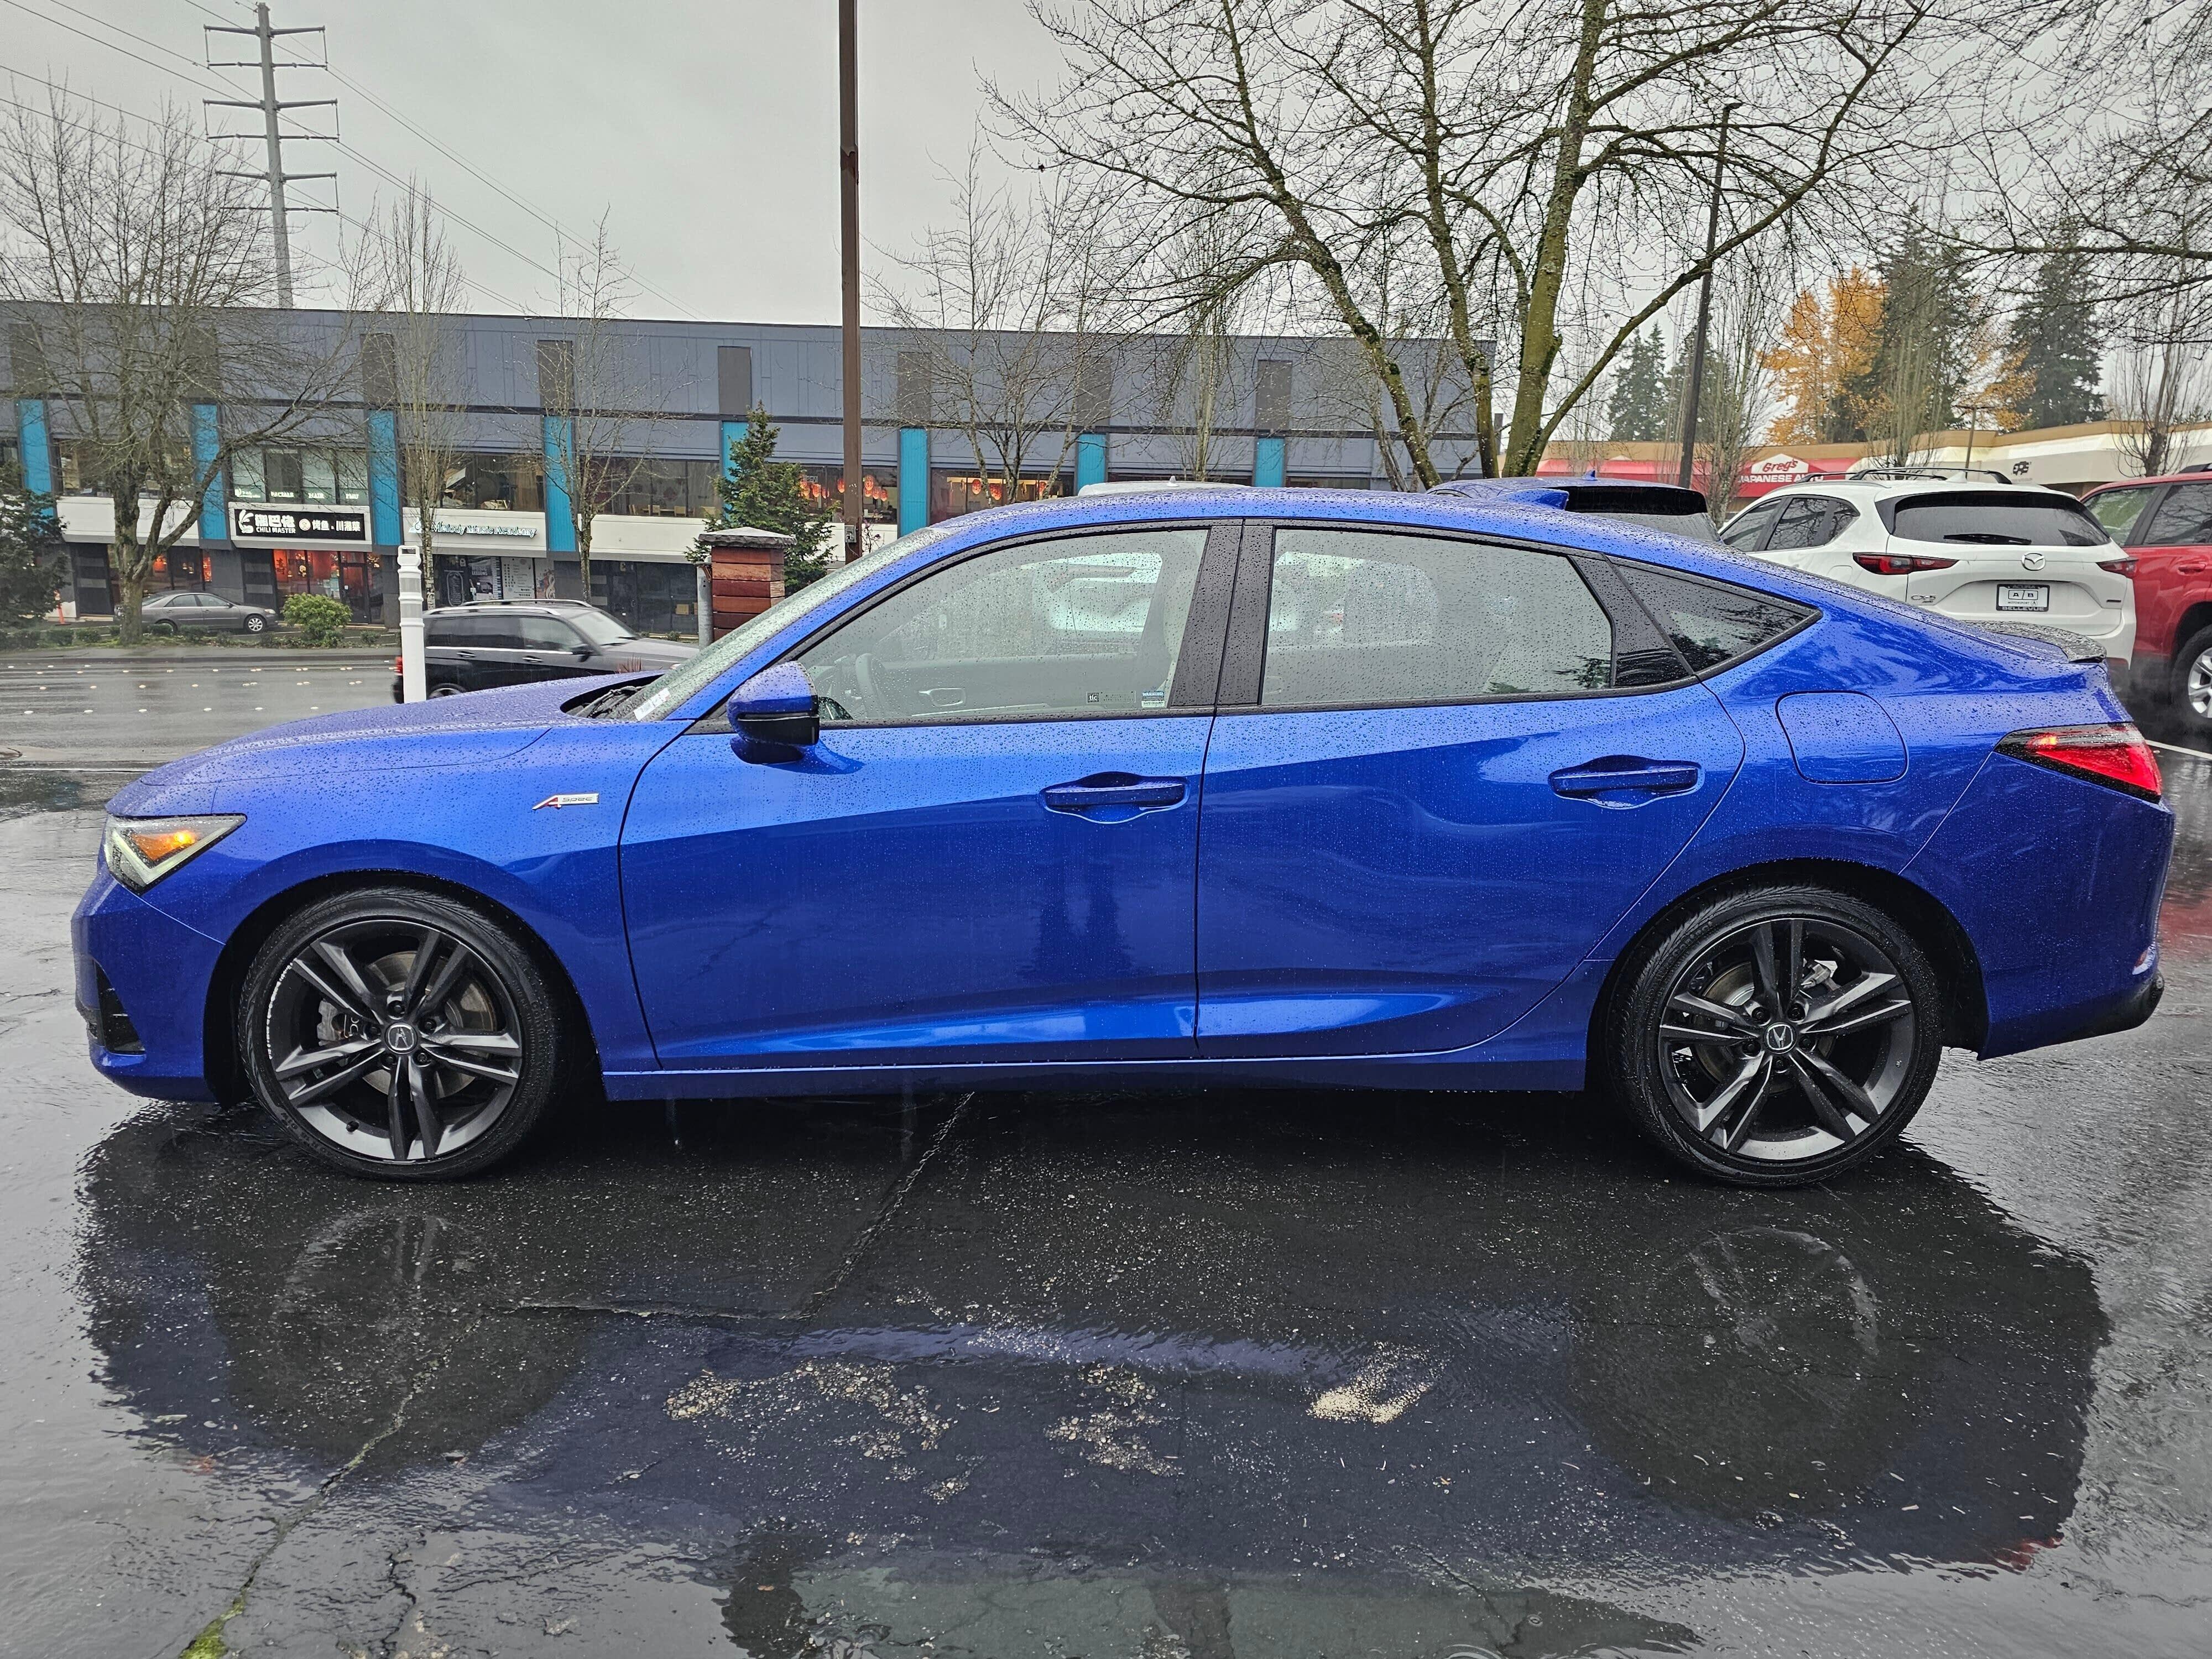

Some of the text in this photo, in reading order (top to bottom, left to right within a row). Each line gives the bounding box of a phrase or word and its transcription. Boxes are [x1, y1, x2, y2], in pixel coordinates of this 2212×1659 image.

[1762, 458, 1798, 472] Greg's
[1739, 474, 1792, 483] JAPANESE
[431, 521, 537, 538] Melody Music Academy
